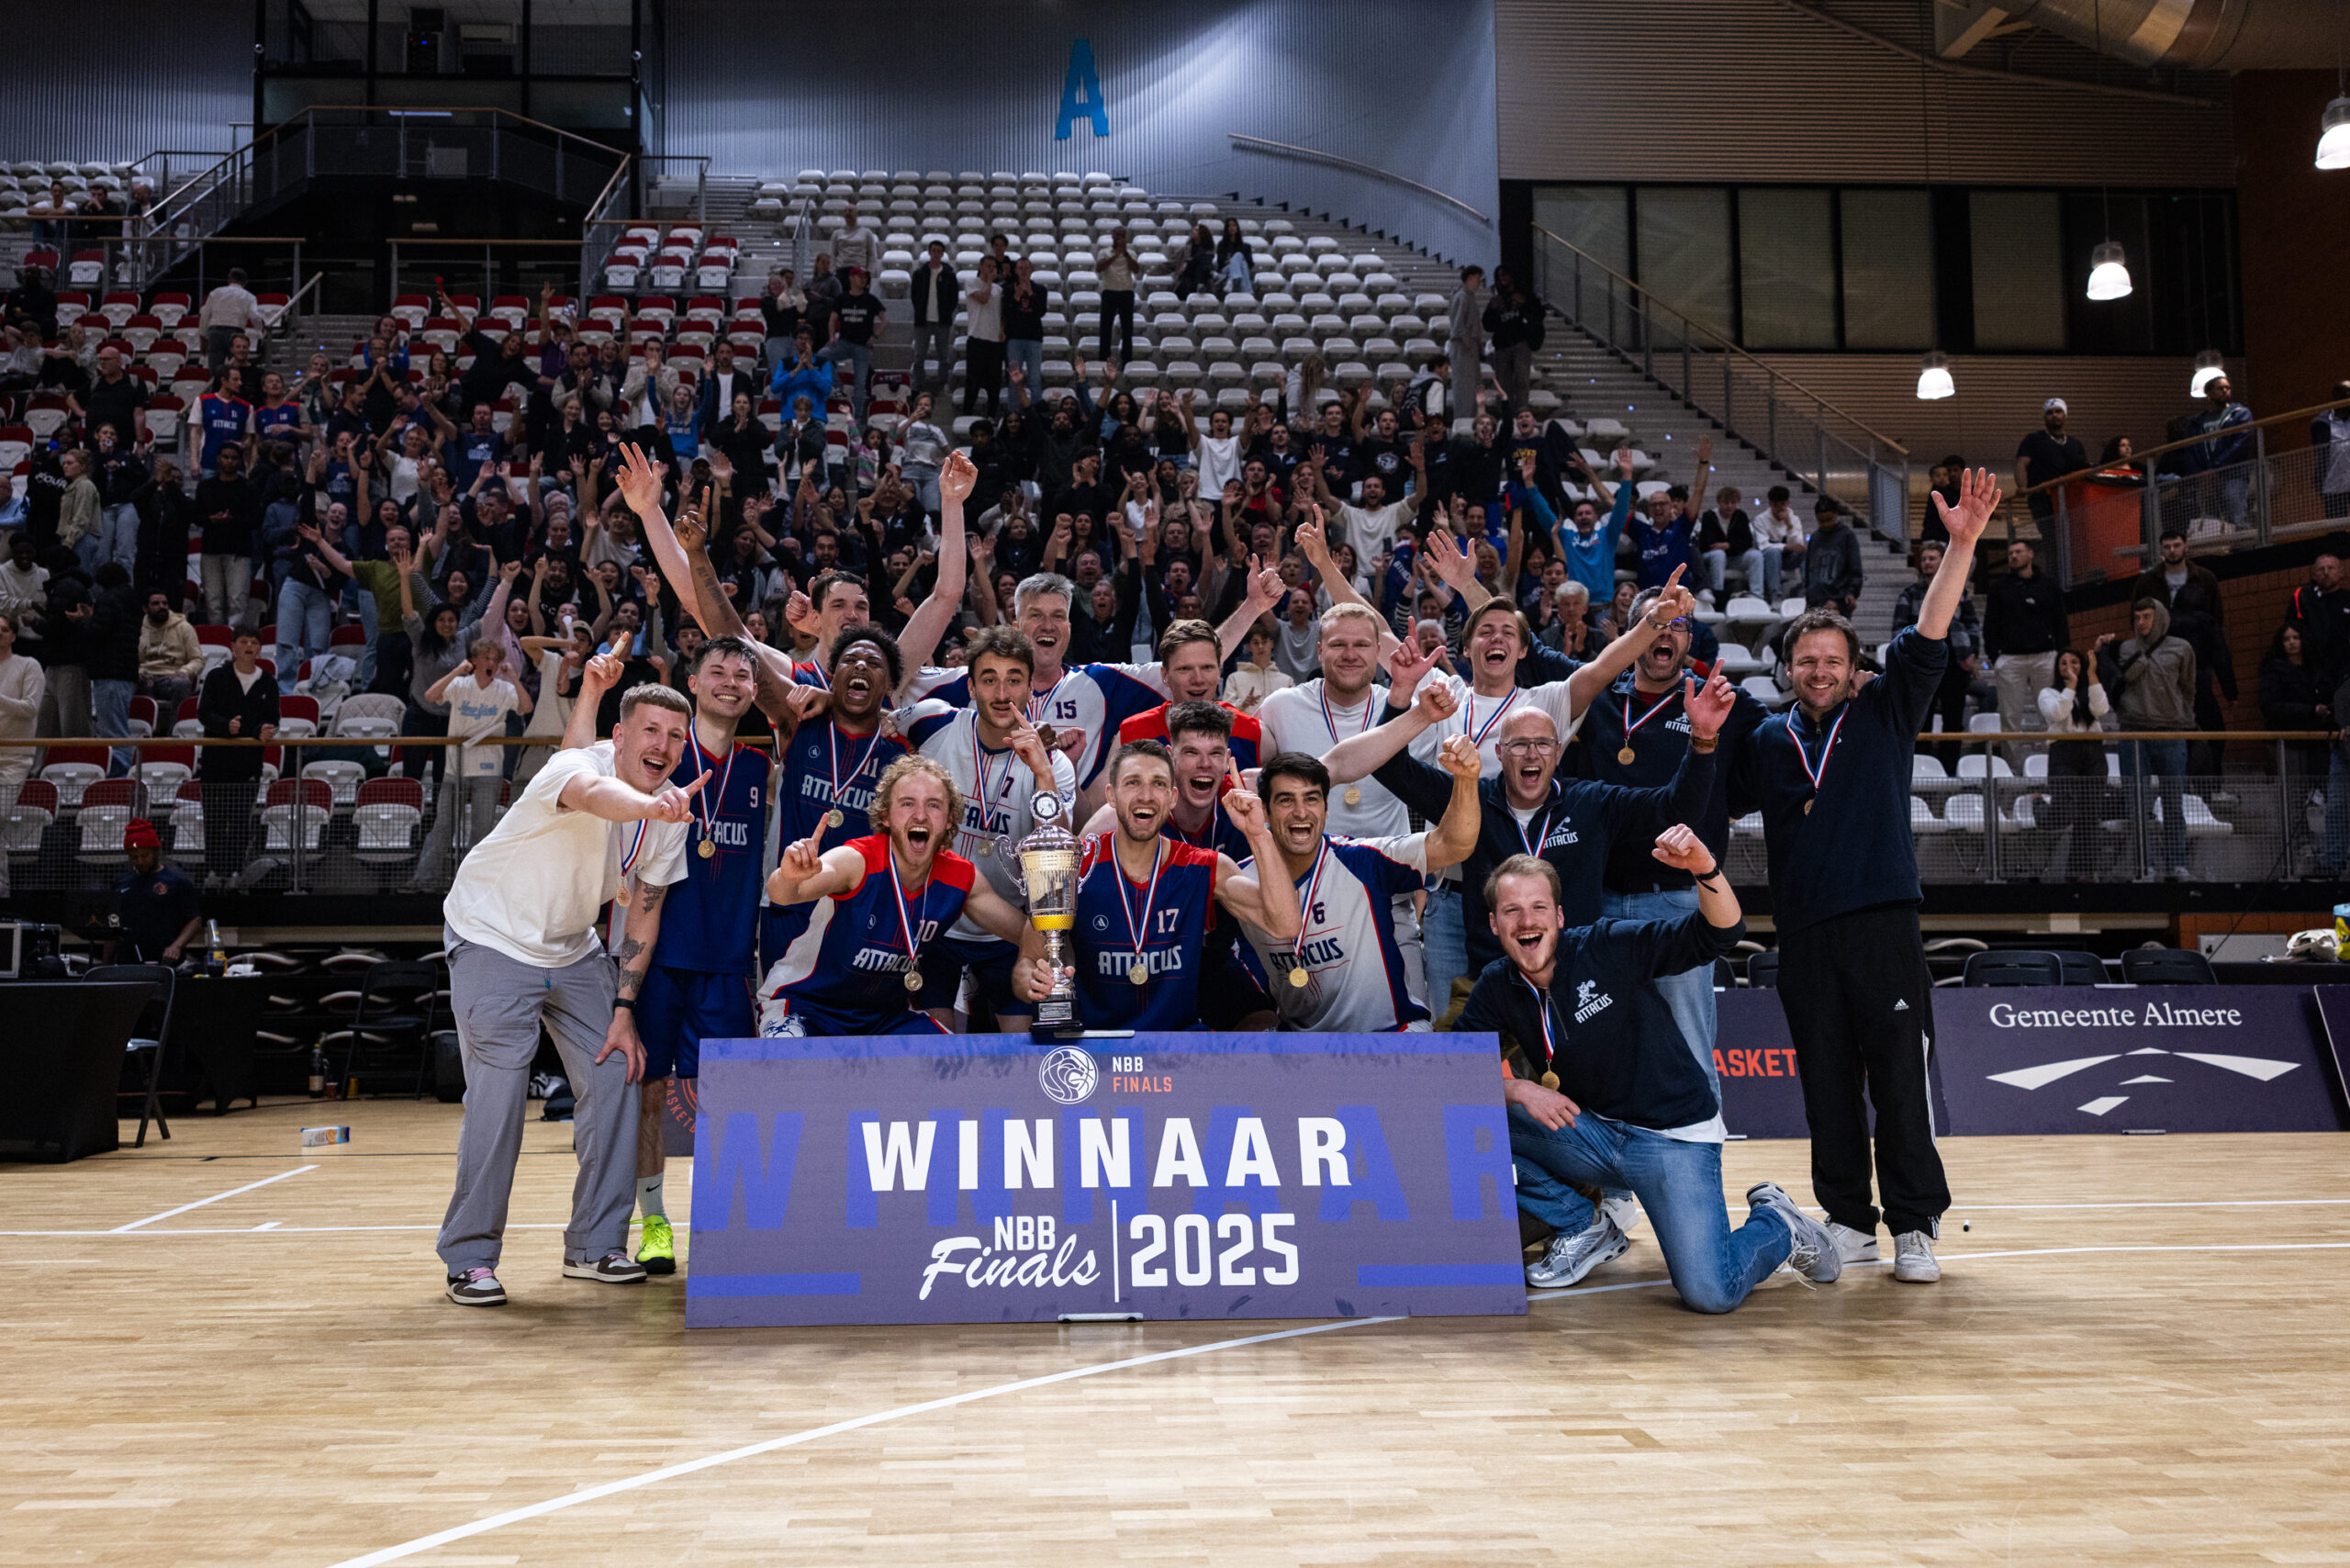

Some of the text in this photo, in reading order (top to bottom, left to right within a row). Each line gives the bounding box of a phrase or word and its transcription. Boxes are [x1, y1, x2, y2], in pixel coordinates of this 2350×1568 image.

[1055, 39, 1109, 140] A
[1056, 700, 1077, 719] 15
[1665, 720, 1692, 734] ATTAC
[750, 787, 759, 808] 9
[1157, 908, 1180, 934] 17
[1312, 902, 1326, 924] 6
[1573, 993, 1613, 1024] ATTACUS
[1989, 1002, 2243, 1027] Gemeente Almere
[1112, 1056, 1144, 1073] NBB
[1713, 1048, 1796, 1077] ASKET
[1113, 1076, 1173, 1093] FINALS
[861, 1116, 1352, 1192] WINNAAR
[994, 1215, 1056, 1251] NBB
[1130, 1213, 1299, 1287] 2025
[919, 1234, 1101, 1301] Finals
